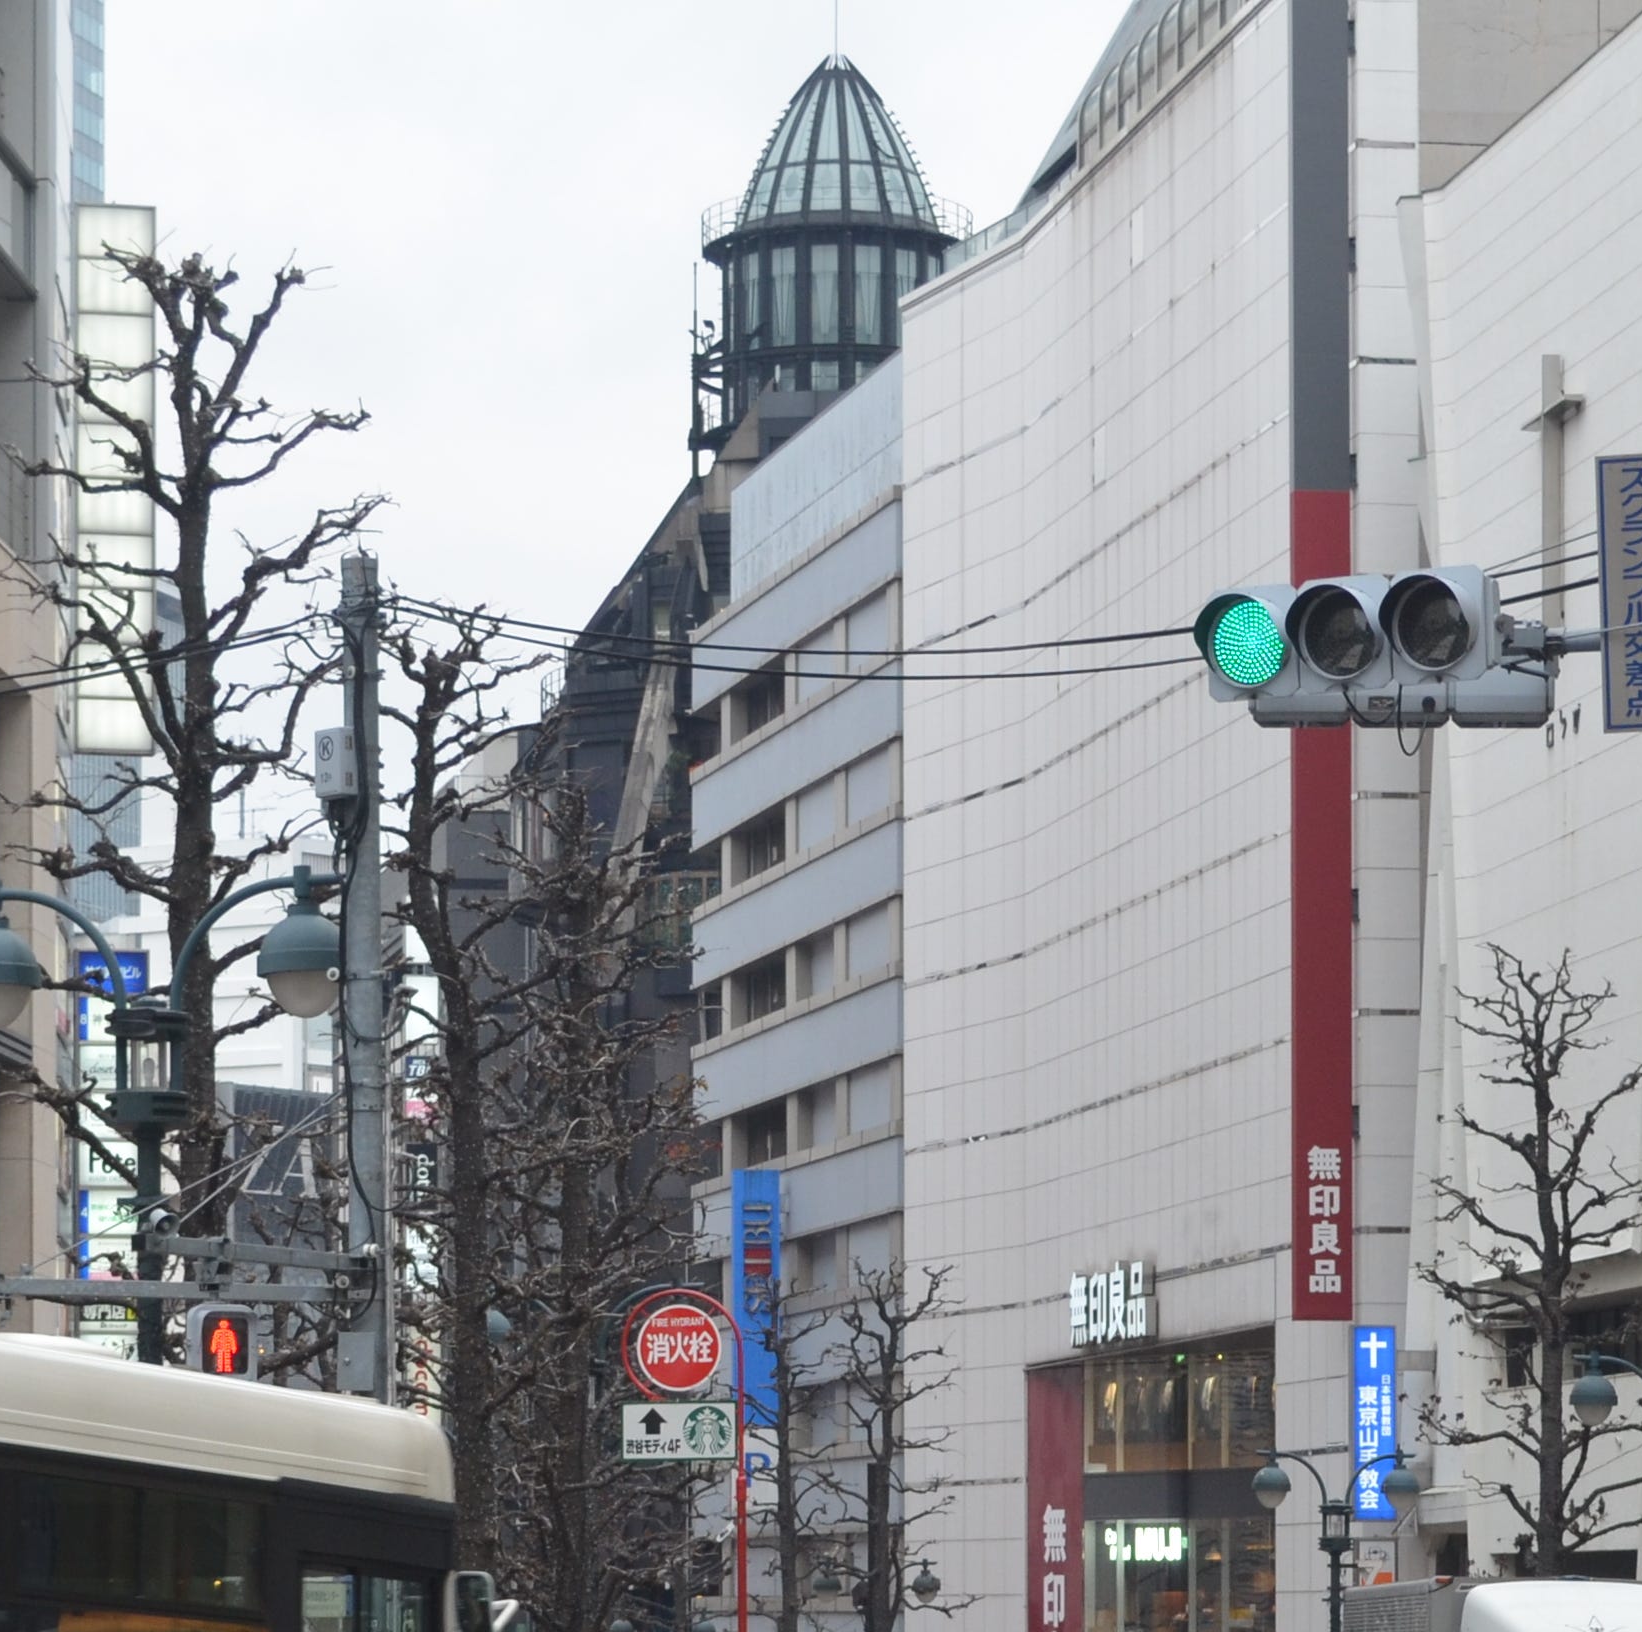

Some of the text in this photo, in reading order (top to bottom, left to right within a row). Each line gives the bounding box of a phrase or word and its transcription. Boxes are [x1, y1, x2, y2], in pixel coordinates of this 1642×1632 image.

[1308, 1145, 1341, 1294] 無印良品
[652, 1317, 705, 1327] FIRE HYDRANT
[1069, 1260, 1147, 1348] 無印良品
[646, 1330, 714, 1365] 消火栓
[626, 1438, 681, 1454] 渋谷モディ4F
[1358, 1385, 1379, 1510] 東京山手教会
